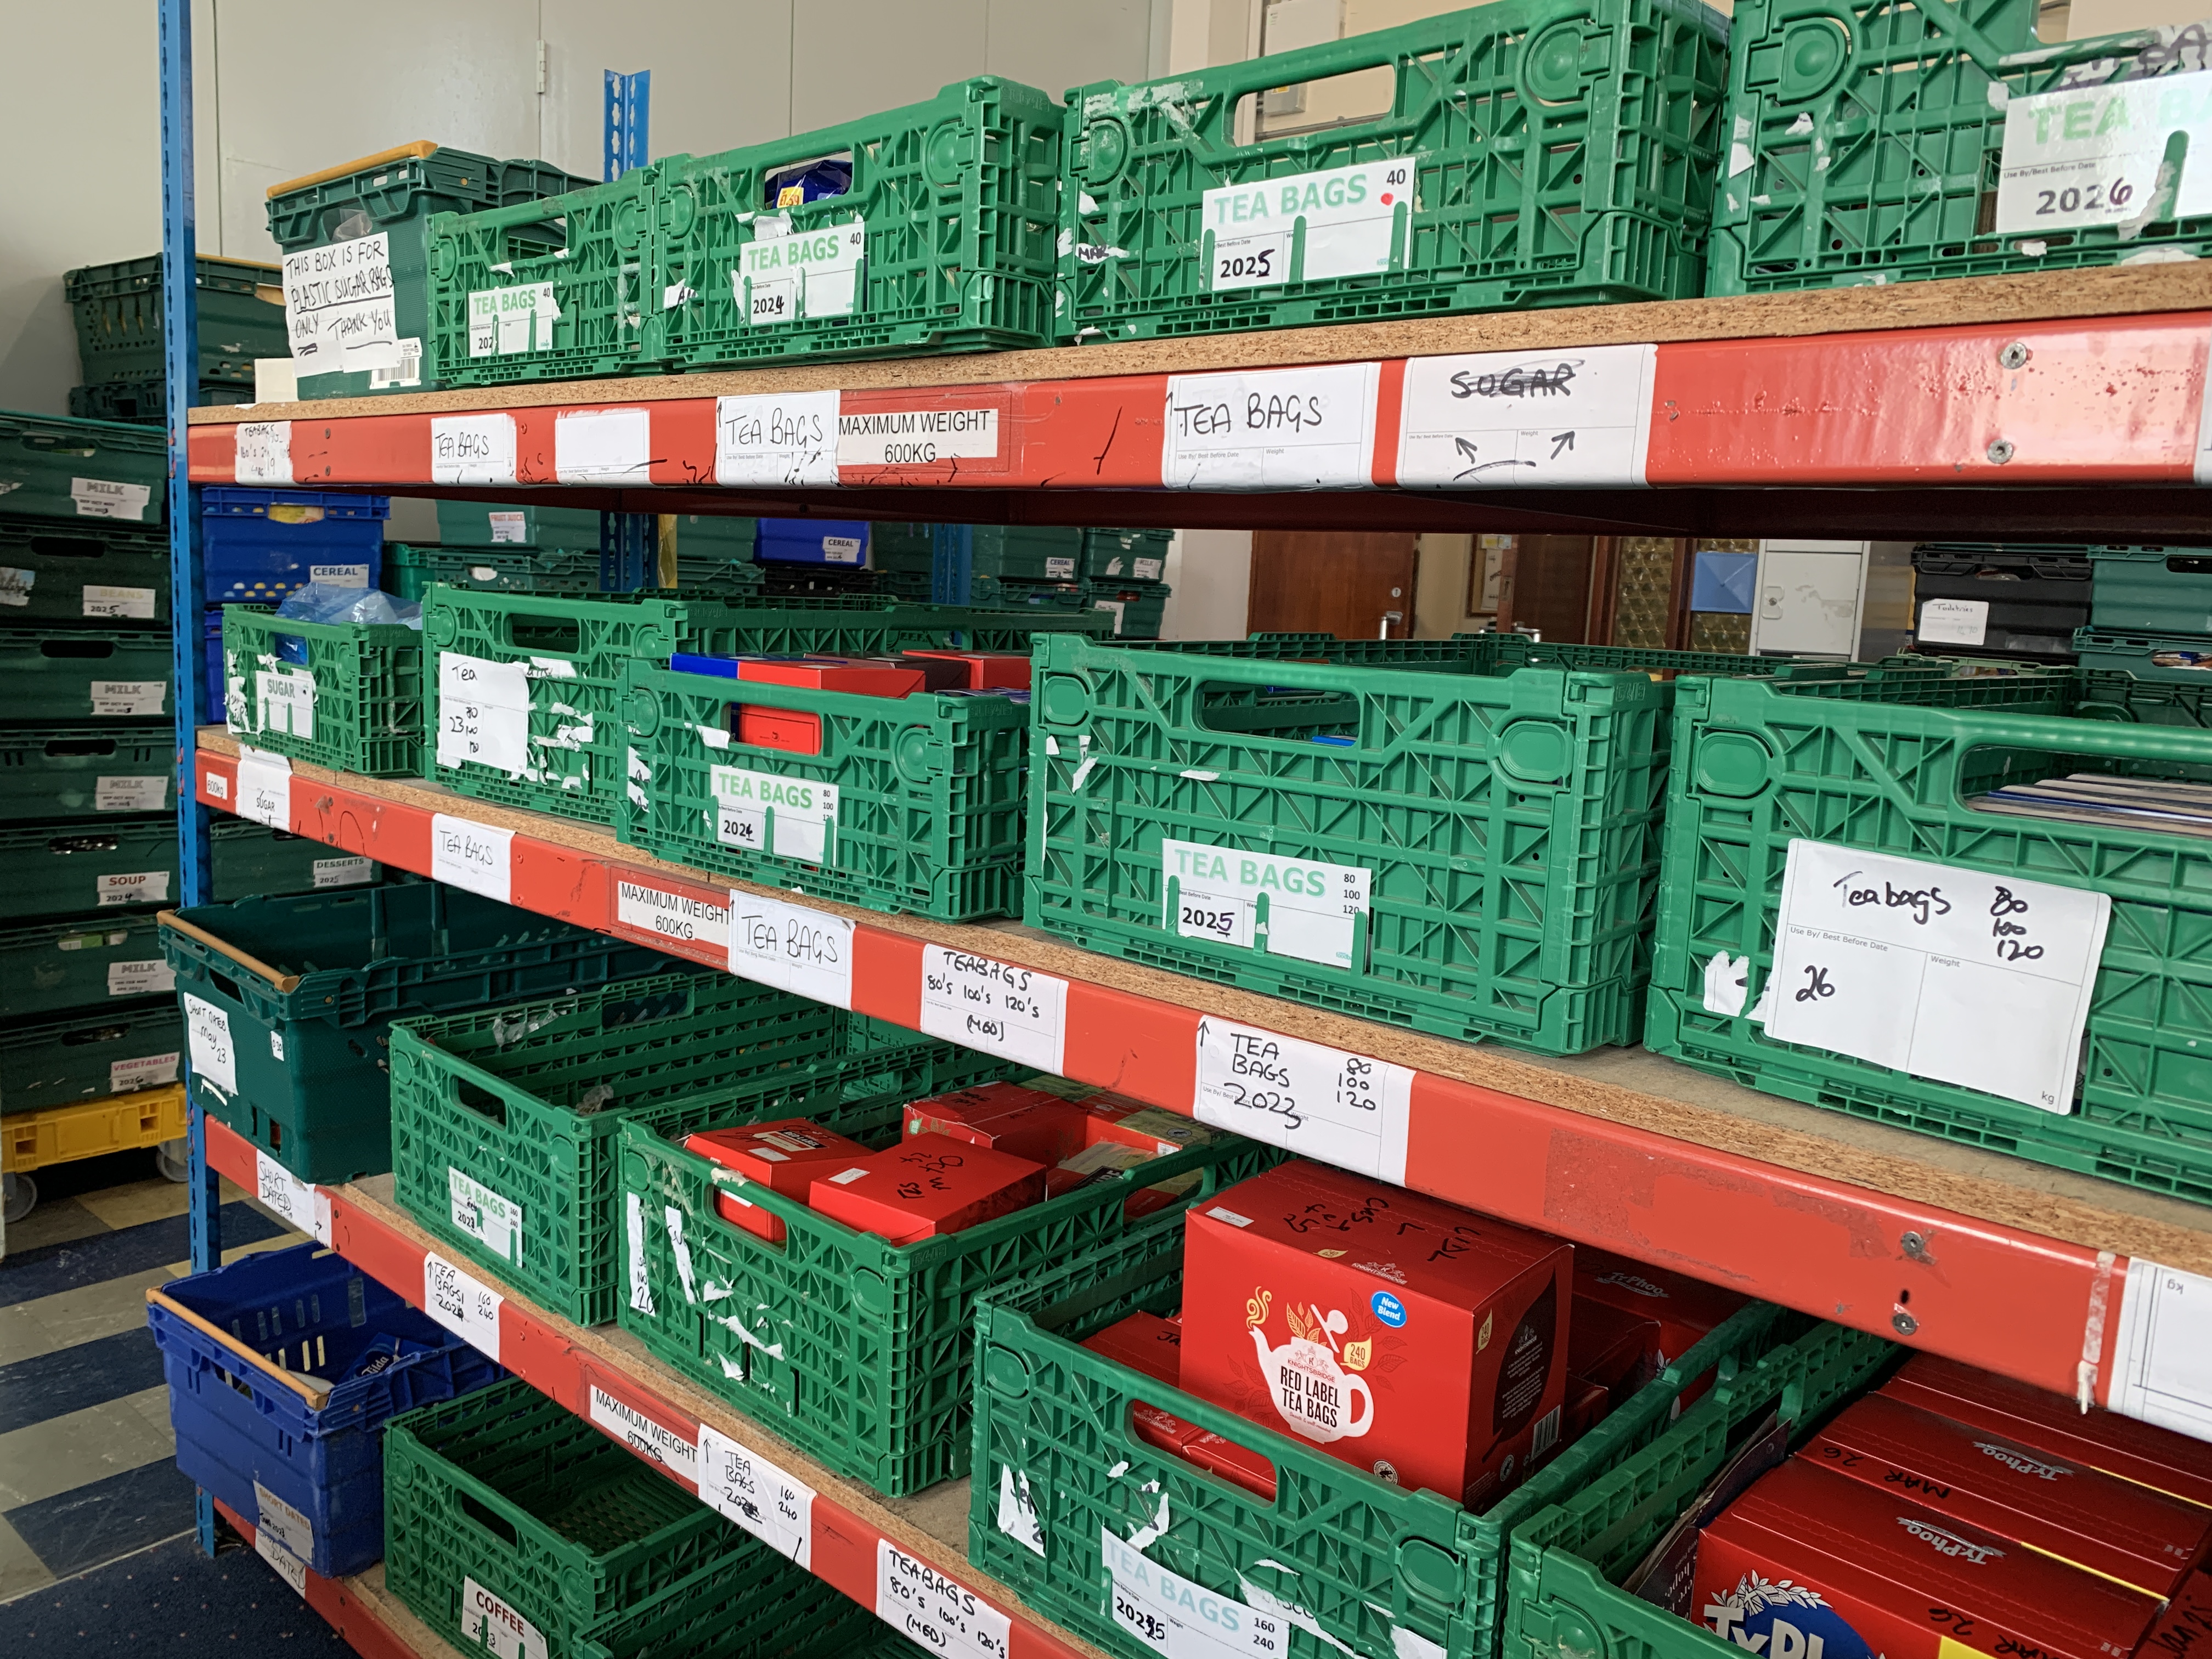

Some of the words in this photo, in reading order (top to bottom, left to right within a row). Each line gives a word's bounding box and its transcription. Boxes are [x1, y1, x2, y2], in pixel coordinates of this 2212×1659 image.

[2028, 97, 2132, 145] TEA
[1386, 168, 1406, 185] 40
[779, 194, 799, 207] £1.59
[1214, 191, 1269, 224] TEA
[1281, 174, 1367, 215] BAGS
[2036, 176, 2133, 215] 2026
[286, 256, 309, 279] THIS
[315, 249, 336, 272] BOX
[342, 246, 352, 266] IS
[358, 240, 385, 264] FOR
[748, 246, 782, 272] TEA
[788, 235, 839, 266] BAGS
[850, 232, 861, 245] 40
[1220, 249, 1275, 278] 2025
[291, 281, 331, 313] PLASTIC
[335, 270, 371, 299] SUGAR
[369, 264, 395, 292] BAGS
[543, 287, 550, 297] 40
[474, 296, 498, 315] TEA
[502, 289, 537, 312] BAGS
[753, 295, 785, 314] 2024
[295, 313, 318, 338] ONLY
[328, 312, 368, 340] THANK
[371, 309, 392, 335] YOU
[1451, 363, 1576, 399] SUGAR
[839, 412, 916, 436] MAXIMUM
[919, 410, 990, 433] WEIGHT
[1175, 404, 1232, 436] TEA
[1247, 393, 1323, 432] BAGS
[725, 415, 762, 445] TEA
[770, 408, 823, 448] BAGS
[435, 432, 455, 459] TEA
[458, 432, 489, 459] BAGS
[884, 443, 936, 463] 600KG
[87, 482, 125, 495] MILK
[828, 539, 854, 547] CEREAL
[313, 567, 358, 577] CEREAL
[100, 588, 144, 599] BEANS
[91, 605, 120, 614] 2025
[452, 662, 477, 681] Tea
[105, 685, 142, 695] MILK
[267, 679, 295, 698] SUGAR
[450, 716, 464, 732] 23
[110, 780, 144, 788] MILK
[207, 780, 224, 797] 600kg
[718, 772, 753, 798] TEA
[760, 780, 812, 809] BAGS
[823, 789, 831, 798] 80
[256, 795, 275, 813] SUGAR
[822, 802, 833, 810] 100
[439, 830, 461, 854] TEA
[465, 835, 493, 865] BAGS
[317, 858, 364, 869] DESSERTS
[1175, 848, 1229, 882] TEA
[1240, 859, 1325, 898] BAGS
[109, 876, 146, 886] SOUP
[1344, 873, 1356, 883] 80
[106, 892, 133, 902] 2024
[621, 883, 678, 912] MAXIMUM
[681, 899, 730, 926] WEIGHT
[1344, 889, 1361, 900] 100
[1990, 886, 2028, 916] 80
[1182, 907, 1235, 932] 2025
[1343, 905, 1359, 915] 120
[655, 915, 693, 939] 600KG
[1993, 917, 2027, 937] 100
[741, 915, 777, 951] TEA
[787, 919, 838, 964] BAGS
[1790, 927, 1804, 935] Use
[1806, 928, 1821, 939] By/
[1823, 932, 1841, 942] Best
[1842, 936, 1868, 946] Before
[1870, 942, 1888, 952] Date
[1997, 939, 2044, 961] 120
[121, 962, 157, 974] MILK
[944, 951, 1032, 991] TEABAGS
[1931, 955, 1961, 968] Weight
[1796, 965, 1836, 1002] 26
[928, 973, 953, 995] 80's
[964, 985, 991, 1004] 100's
[1006, 995, 1040, 1018] 120's
[200, 1026, 217, 1049] May
[1230, 1032, 1279, 1060] TEA
[113, 1056, 176, 1071] VEGETABLES
[217, 1048, 226, 1064] 23
[1347, 1058, 1372, 1075] 80
[1232, 1053, 1290, 1087] BAGS
[1338, 1073, 1370, 1090] 100
[1213, 1088, 1221, 1097] By/
[1223, 1092, 1234, 1100] Best
[1337, 1091, 1376, 1110] 120
[2041, 1092, 2055, 1105] kg
[1224, 1082, 1301, 1129] 2023
[258, 1161, 287, 1192] SHORT
[261, 1183, 292, 1212] DATED
[452, 1173, 472, 1199] TEA
[476, 1187, 506, 1219] BAGS
[435, 1262, 456, 1282] TEA
[1351, 1262, 1408, 1285] KNIGHTSBRIDGE
[1609, 1272, 1664, 1294] TyPhoo
[2167, 1278, 2184, 1295] kg
[478, 1291, 491, 1306] 160
[1381, 1296, 1400, 1311] New
[478, 1305, 494, 1320] 240
[1378, 1306, 1401, 1322] Blend
[1350, 1357, 1365, 1368] BAGS
[1351, 1344, 1365, 1360] 240
[362, 1356, 389, 1376] Tilda
[1288, 1358, 1335, 1383] KNIGHTSBRIDGE
[1281, 1365, 1301, 1391] RED
[1306, 1376, 1340, 1409] LABEL
[1283, 1387, 1302, 1414] TEA
[1307, 1398, 1337, 1427] BAGS
[596, 1389, 647, 1434] MAXIMUM
[651, 1423, 698, 1463] WEIGHT
[628, 1430, 662, 1463] 600KG
[725, 1450, 751, 1476] TEA
[1982, 1446, 2059, 1481] TyPhoo
[725, 1465, 754, 1494] BAGS
[781, 1485, 795, 1500] 160
[285, 1505, 311, 1531] DATED
[778, 1501, 797, 1520] 240
[1907, 1524, 1988, 1565] TyPhoo
[270, 1549, 306, 1590] DATED
[889, 1549, 975, 1616] TEABAGS
[1106, 1537, 1150, 1587] TEA
[1160, 1575, 1240, 1632] BAGS
[476, 1591, 524, 1638] COFFEE
[890, 1576, 925, 1609] 80's
[939, 1607, 966, 1633] 100's
[978, 1630, 1005, 1659] 120's
[1169, 1617, 1184, 1629] Weight
[1254, 1617, 1276, 1633] 160
[906, 1614, 946, 1647] (MED)
[1253, 1634, 1274, 1651] 240
